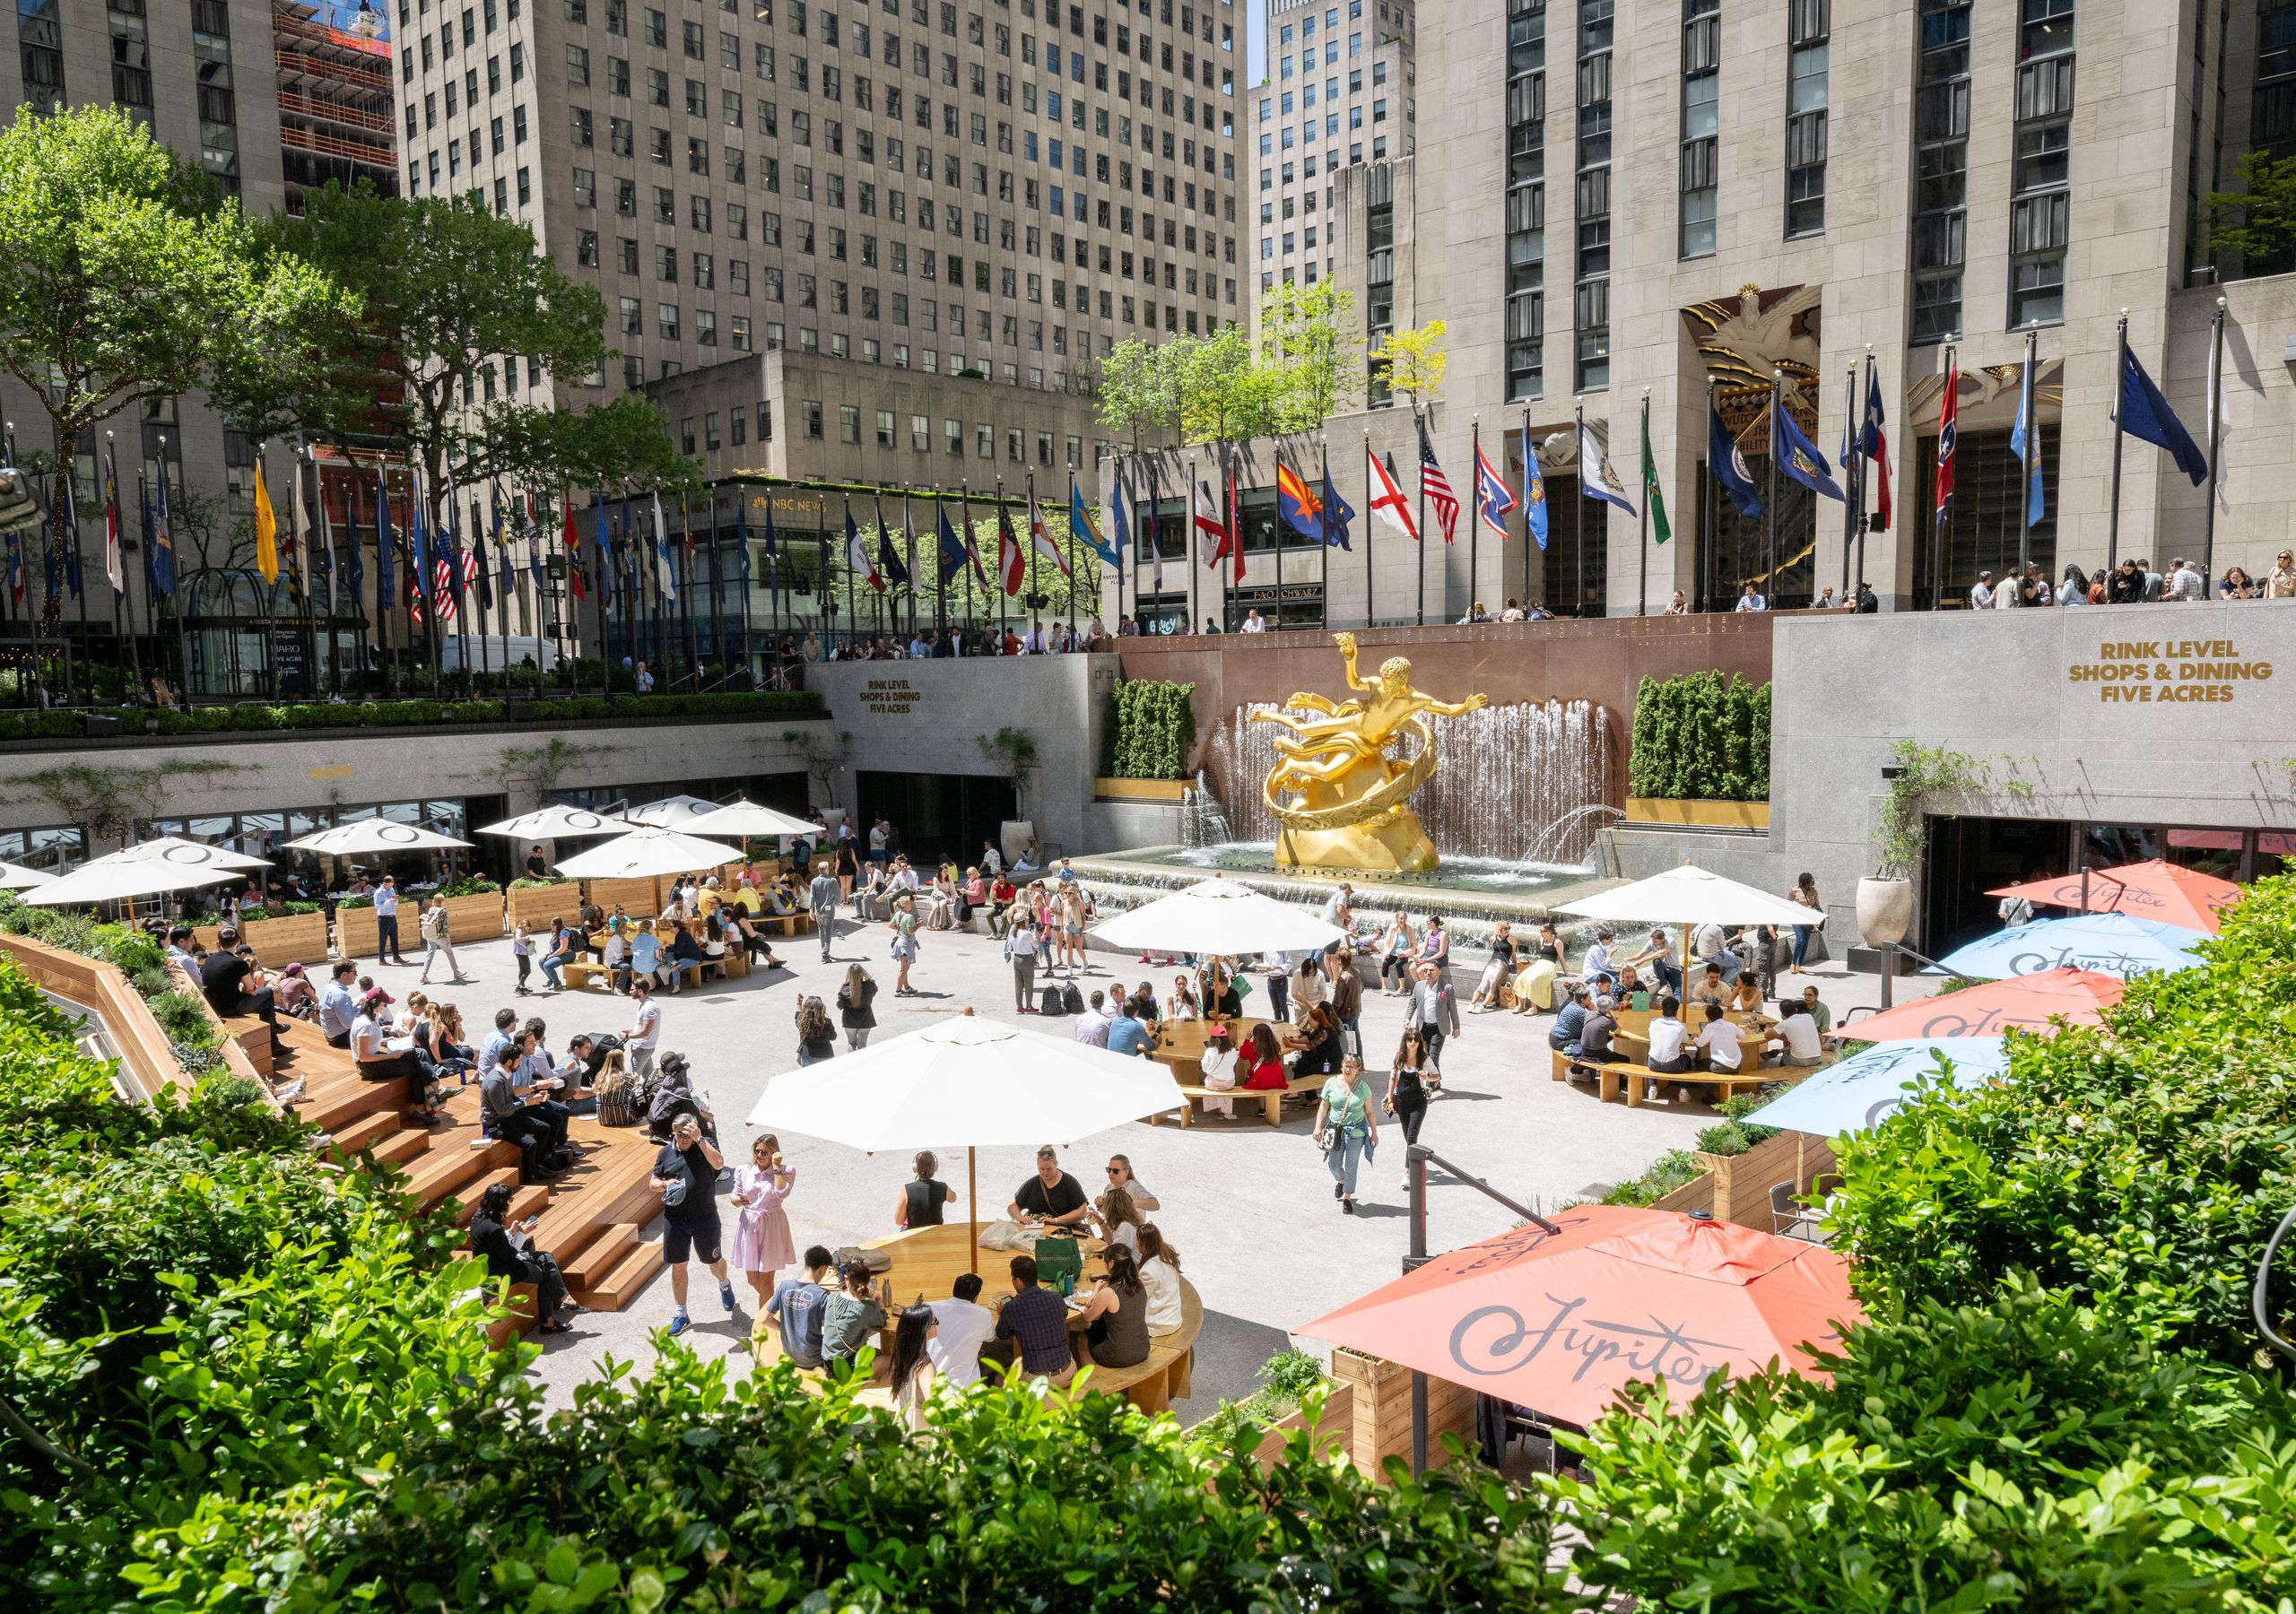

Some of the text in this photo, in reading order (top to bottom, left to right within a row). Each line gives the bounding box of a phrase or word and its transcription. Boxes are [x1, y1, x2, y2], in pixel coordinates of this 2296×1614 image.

[1802, 419, 1818, 431] THE
[1739, 438, 1770, 451] BILITY
[772, 498, 827, 513] NBC NEWS
[1281, 587, 1318, 599] CHWARZ
[1149, 617, 1177, 635] BUEY
[2100, 639, 2239, 660] RINK LEVEL
[2068, 662, 2274, 682] SHOPS & DINING
[868, 680, 910, 690] RINK LEVEL
[859, 691, 920, 702] SHOPS & DINING
[2100, 684, 2234, 703] FIVE ACRES
[870, 704, 910, 714] FIVE ACRES
[1448, 1291, 1744, 1392] Jupiter
